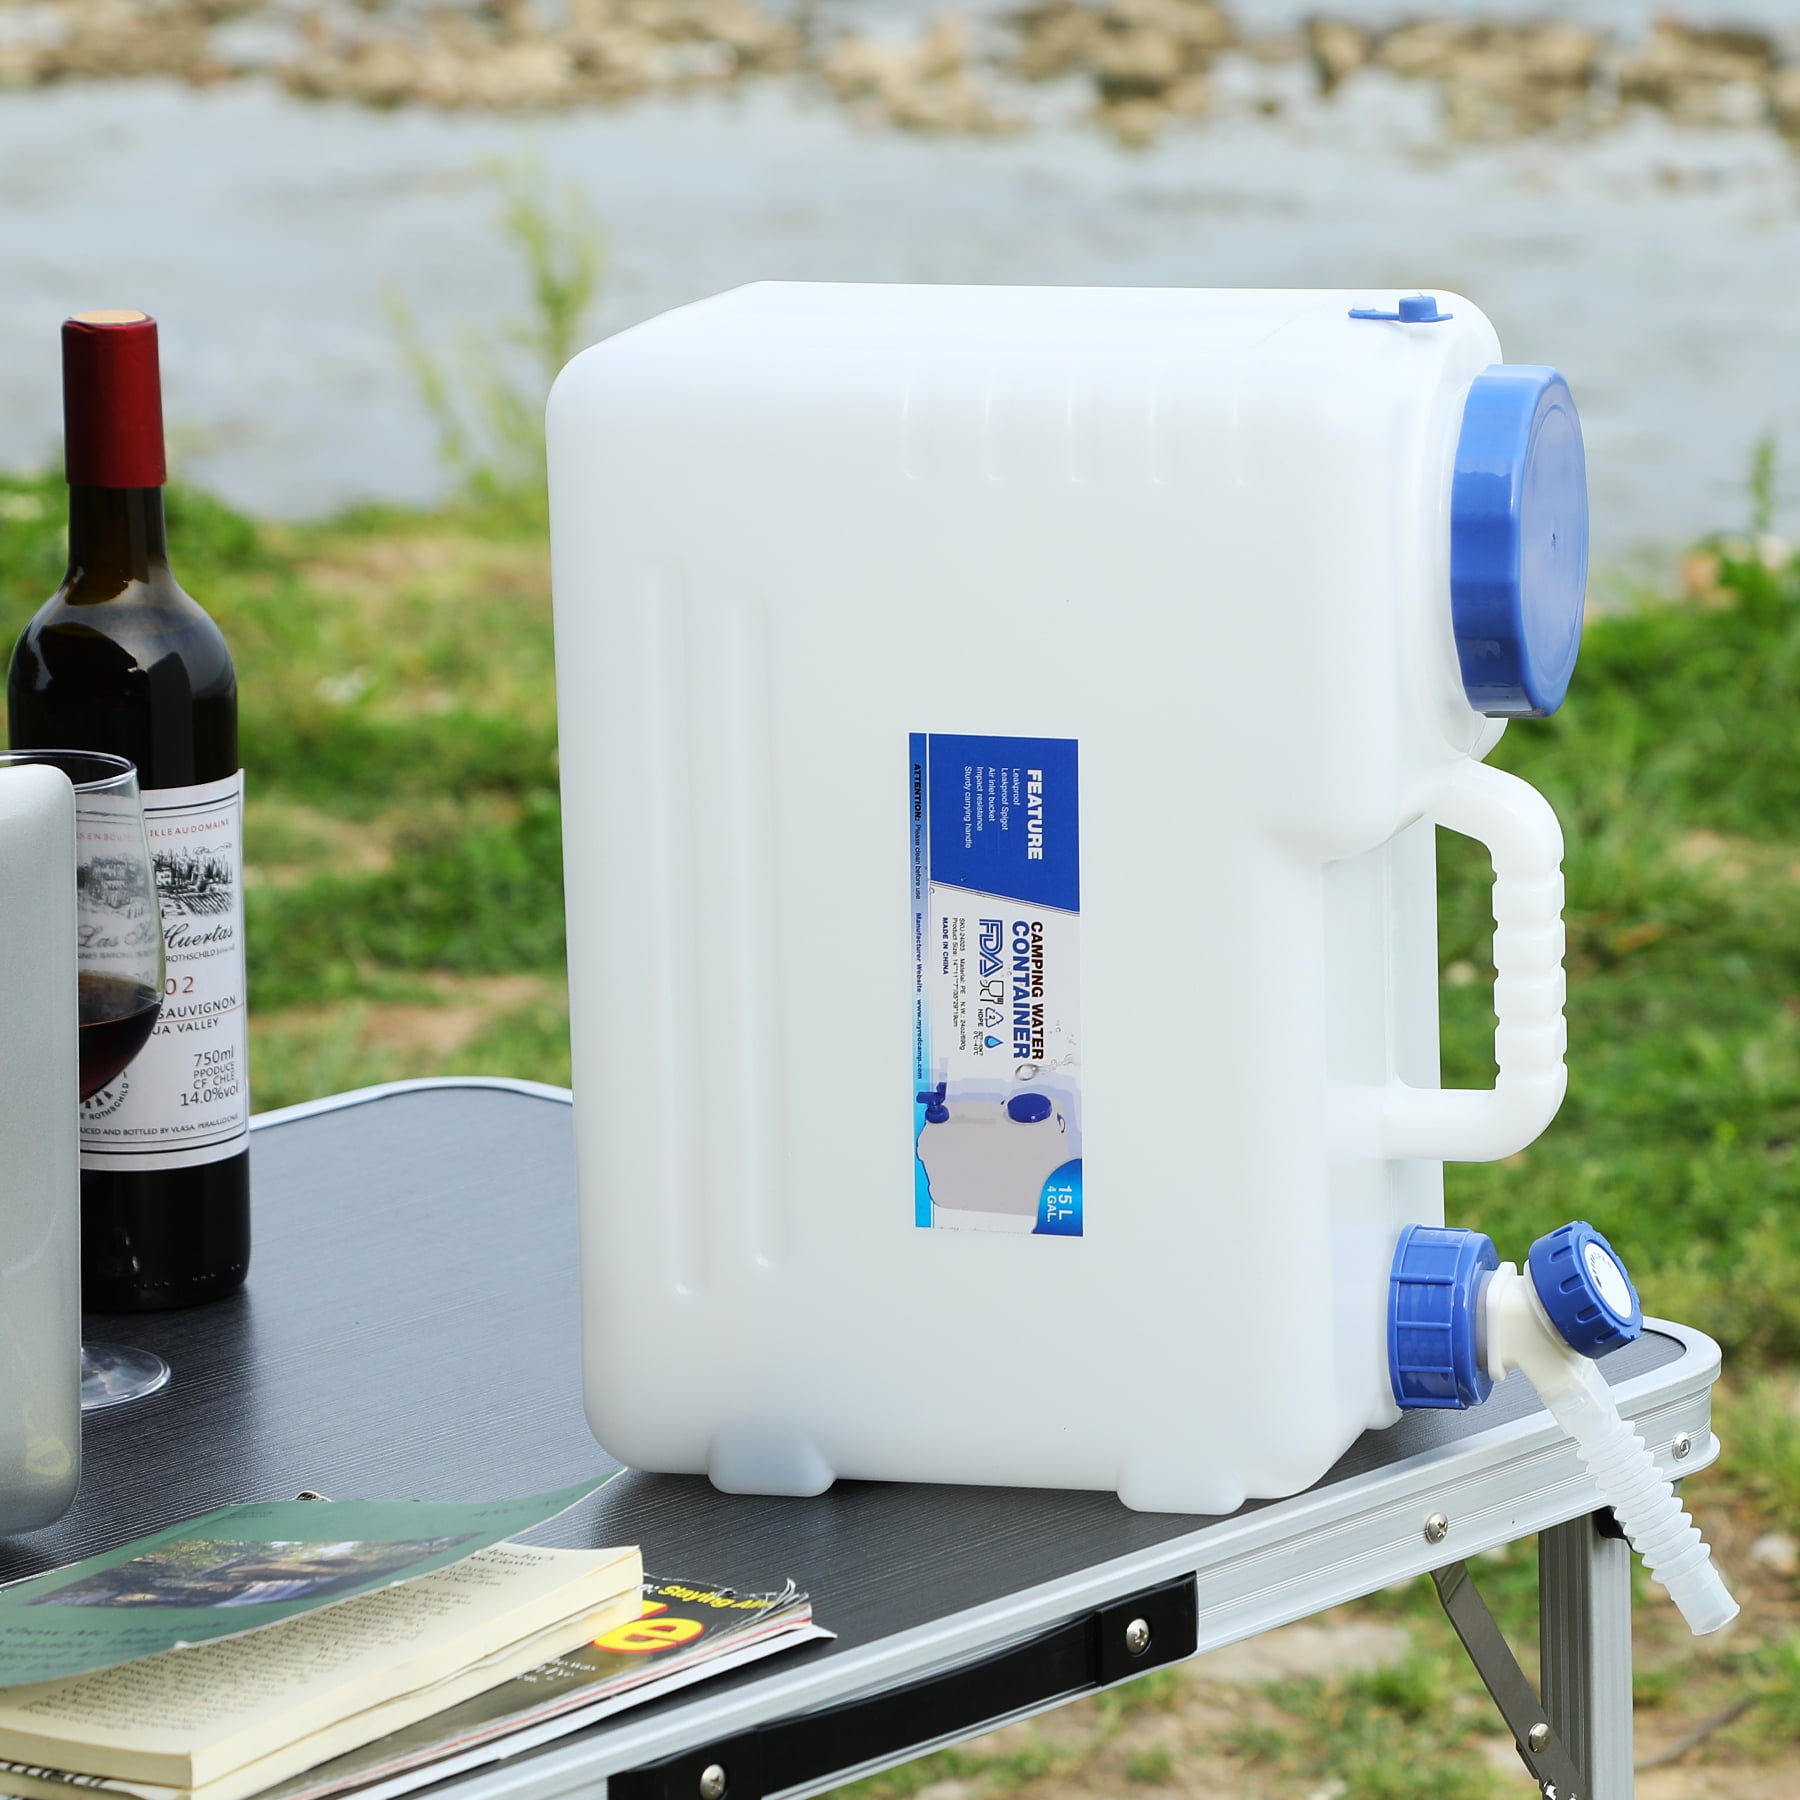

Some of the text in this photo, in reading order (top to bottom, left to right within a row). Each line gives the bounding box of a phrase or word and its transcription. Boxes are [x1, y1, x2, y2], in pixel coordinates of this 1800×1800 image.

[964, 766, 972, 790] Sturdy
[988, 780, 996, 795] inlet
[1012, 768, 1020, 805] Leakproof
[976, 766, 984, 831] Impact resistance
[988, 796, 996, 821] bucket
[1000, 768, 1008, 830] Leakproof Spigot
[1028, 769, 1042, 860] FEATURE
[943, 942, 948, 950] IN
[979, 919, 1003, 978] FDA
[1012, 921, 1030, 1058] CONTAINER
[1032, 922, 1043, 1059] CAMPING WATER
[157, 996, 236, 1020] SAUVIGNON
[152, 1017, 219, 1036] UA VALLEY
[193, 1045, 234, 1067] 750ml
[102, 1128, 121, 1136] AND
[123, 1128, 157, 1136] BOTTLED
[1047, 1195, 1057, 1222] GAL.
[1058, 1184, 1072, 1220] 15 L
[658, 1585, 735, 1608] Staying
